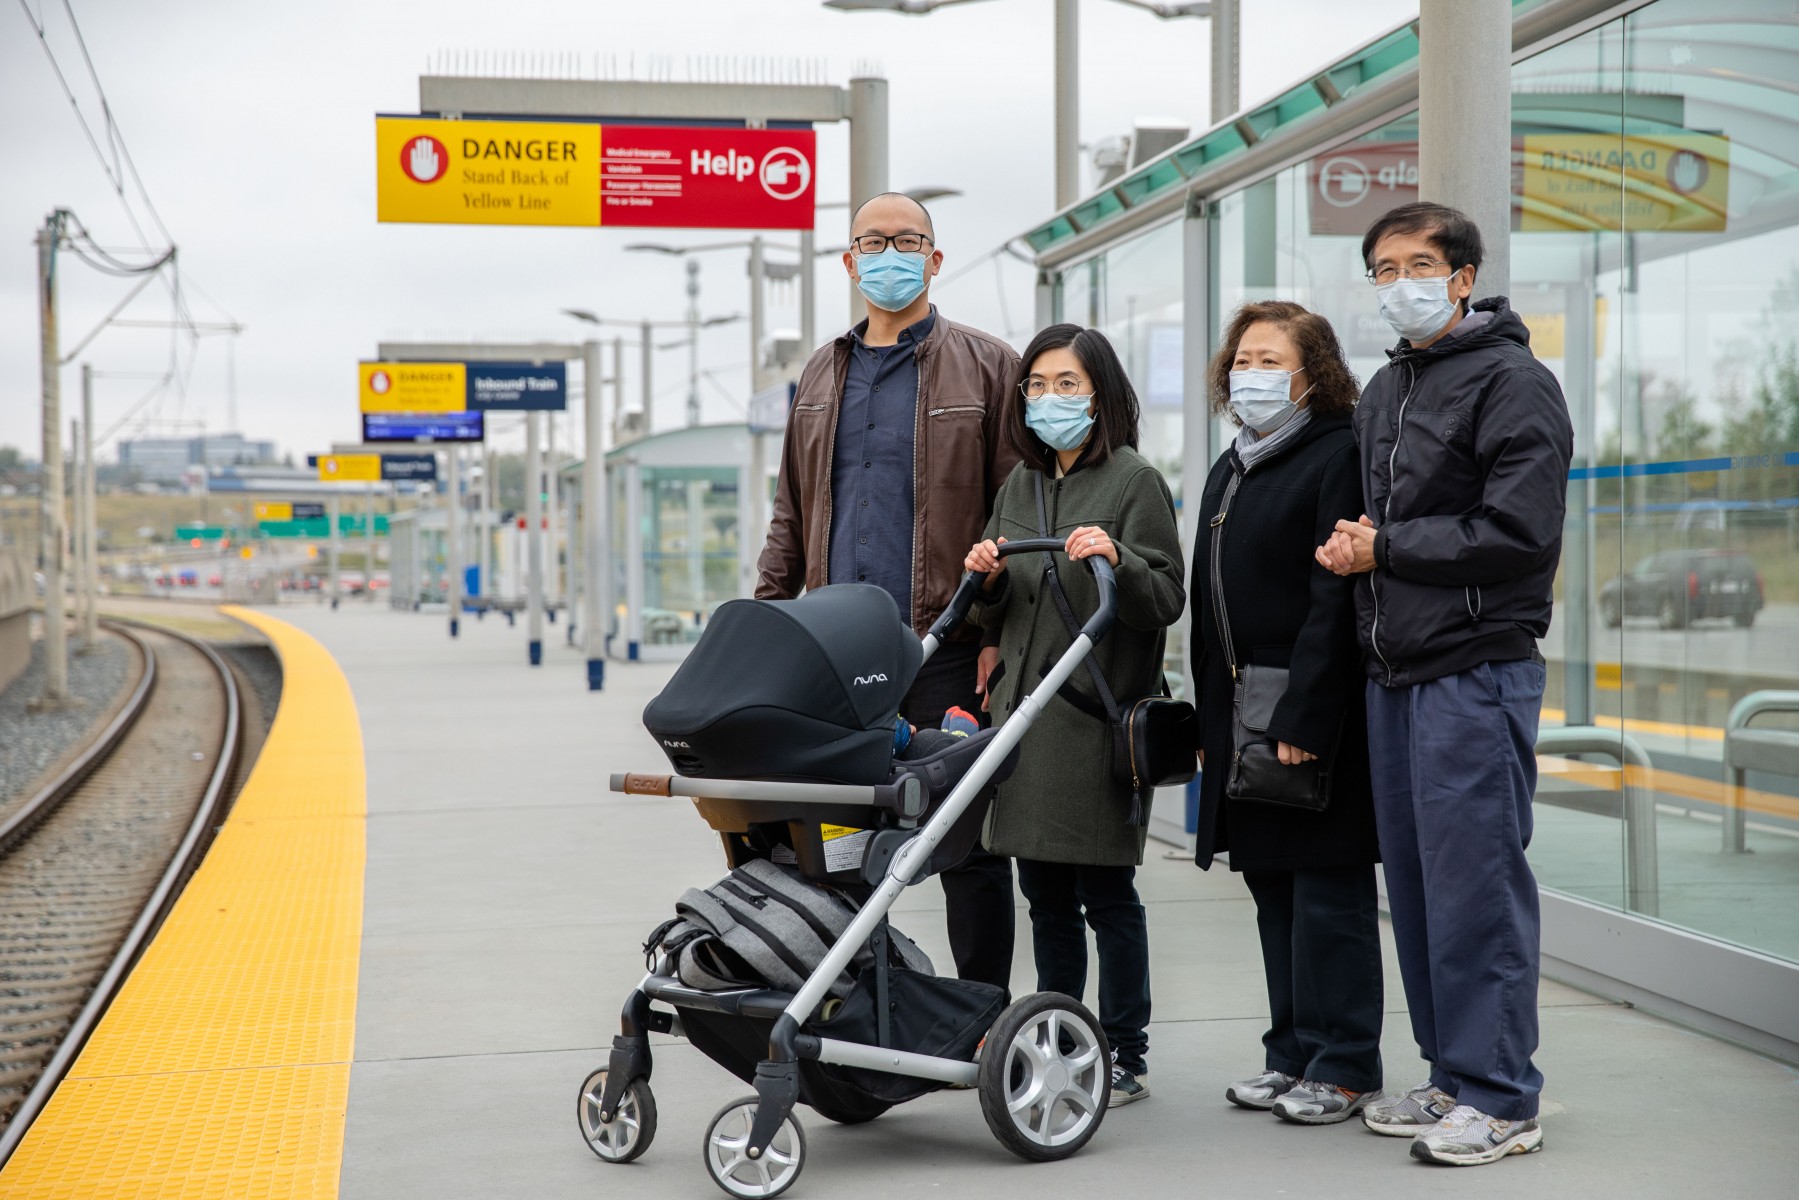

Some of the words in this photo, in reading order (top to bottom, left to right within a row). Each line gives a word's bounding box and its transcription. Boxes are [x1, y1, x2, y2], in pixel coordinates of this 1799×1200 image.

[463, 139, 577, 161] DANGER
[691, 149, 755, 182] Help
[462, 168, 505, 185] Stand
[511, 170, 549, 186] Back
[554, 171, 570, 186] of
[462, 193, 513, 209] Yellow
[519, 194, 552, 210] Line
[854, 673, 888, 686] nuna
[663, 739, 691, 748] nuna
